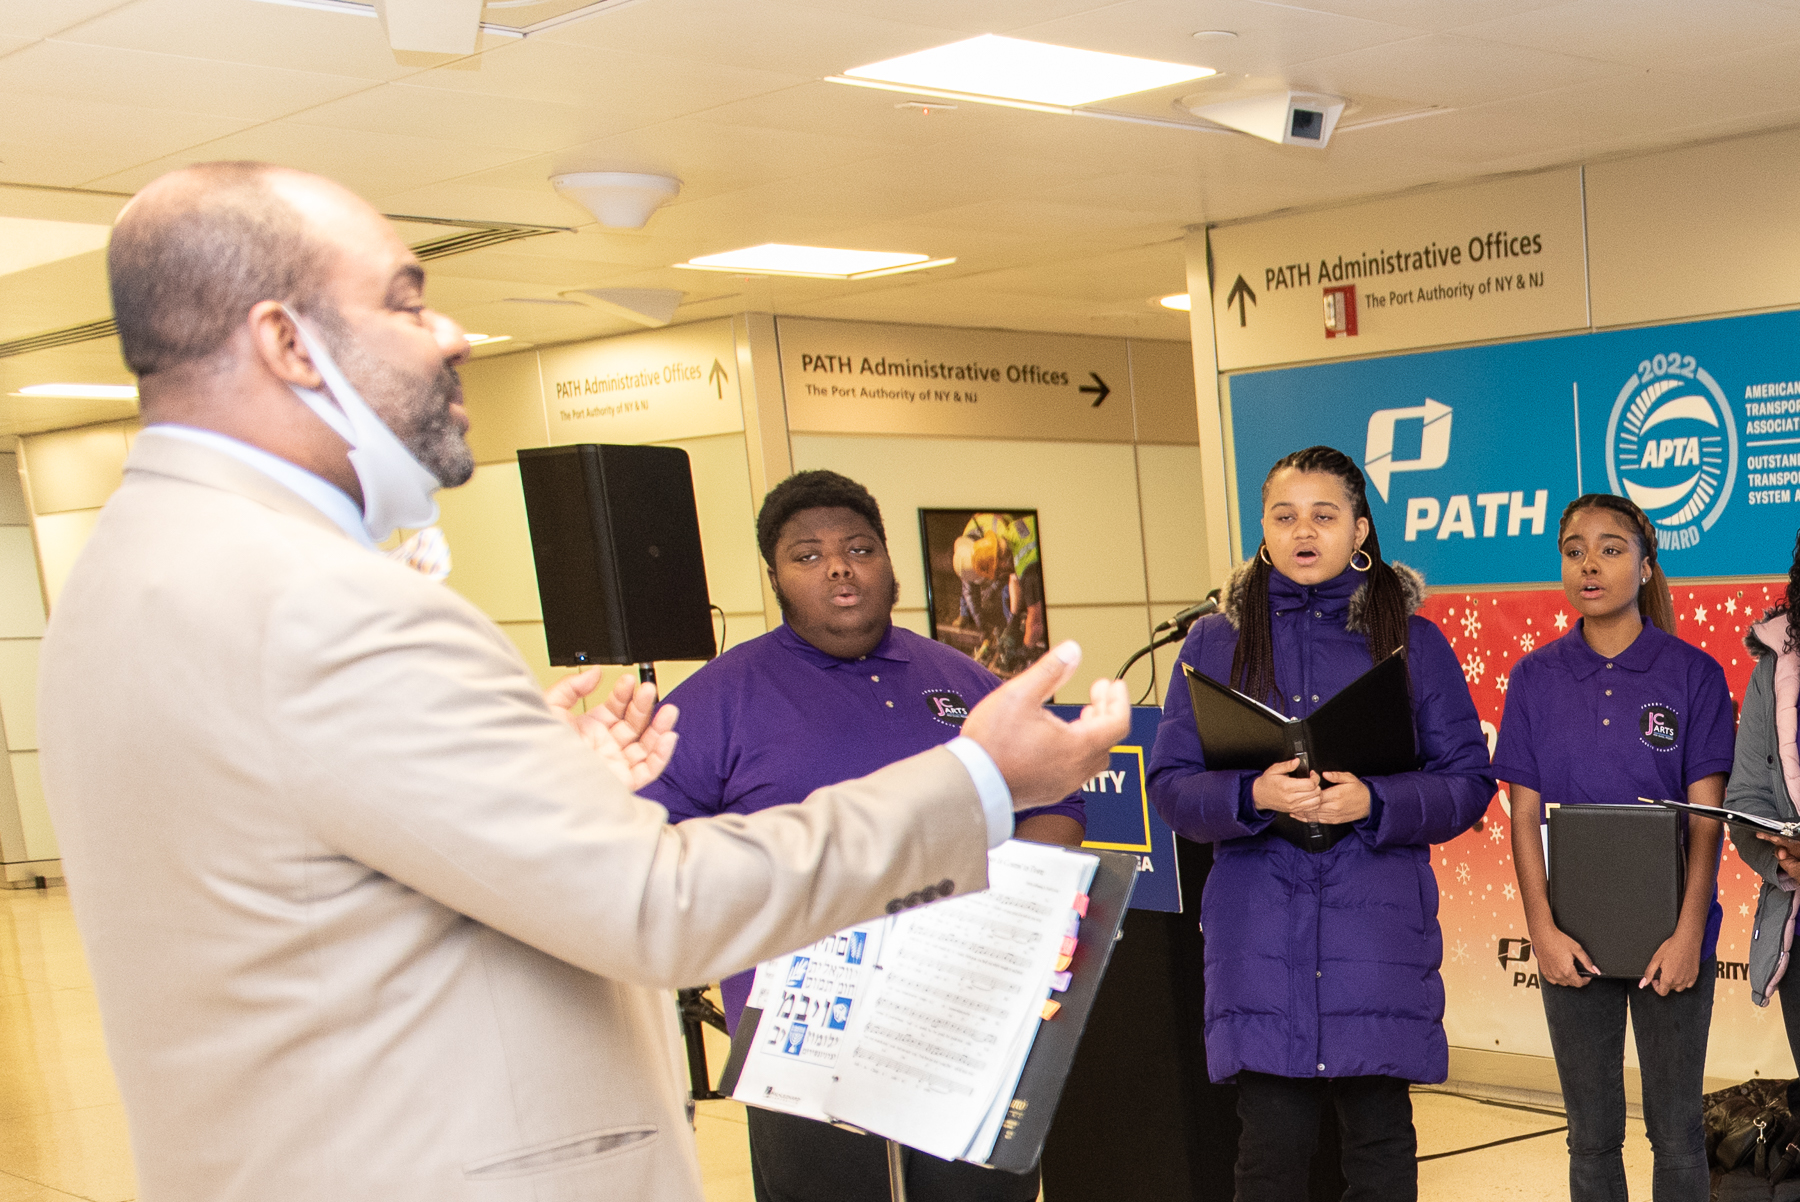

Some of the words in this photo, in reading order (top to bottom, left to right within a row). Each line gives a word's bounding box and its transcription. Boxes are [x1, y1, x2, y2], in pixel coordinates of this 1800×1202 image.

[1265, 263, 1311, 291] PATH
[1317, 242, 1462, 284] Administrative
[1468, 231, 1542, 262] Offices
[1365, 293, 1386, 309] The
[1389, 289, 1414, 306] Port
[1417, 281, 1474, 303] Authority
[1479, 277, 1491, 294] of
[1495, 275, 1513, 292] NY
[1517, 274, 1525, 289] &
[1529, 271, 1544, 288] NJ
[556, 379, 581, 399] PATH
[584, 368, 660, 395] Administrative
[663, 362, 702, 384] Offices
[801, 354, 852, 374] PATH
[859, 356, 1000, 382] Administrative
[1006, 363, 1069, 386] Offices
[1638, 352, 1697, 384] 2022
[805, 384, 828, 396] The
[831, 386, 856, 398] Port
[859, 386, 916, 403] Authority
[919, 389, 931, 401] of
[934, 390, 950, 402] NY
[953, 392, 962, 403] &
[964, 392, 977, 403] NJ
[560, 410, 571, 422] The
[572, 406, 585, 420] Port
[586, 404, 615, 418] Authority
[616, 403, 623, 414] of
[624, 402, 633, 412] NY
[1640, 437, 1700, 469] APTA
[1748, 489, 1791, 505] SYSTEM
[1405, 490, 1548, 542] PATH
[1653, 725, 1674, 736] ARTS
[1513, 971, 1540, 989] PA
